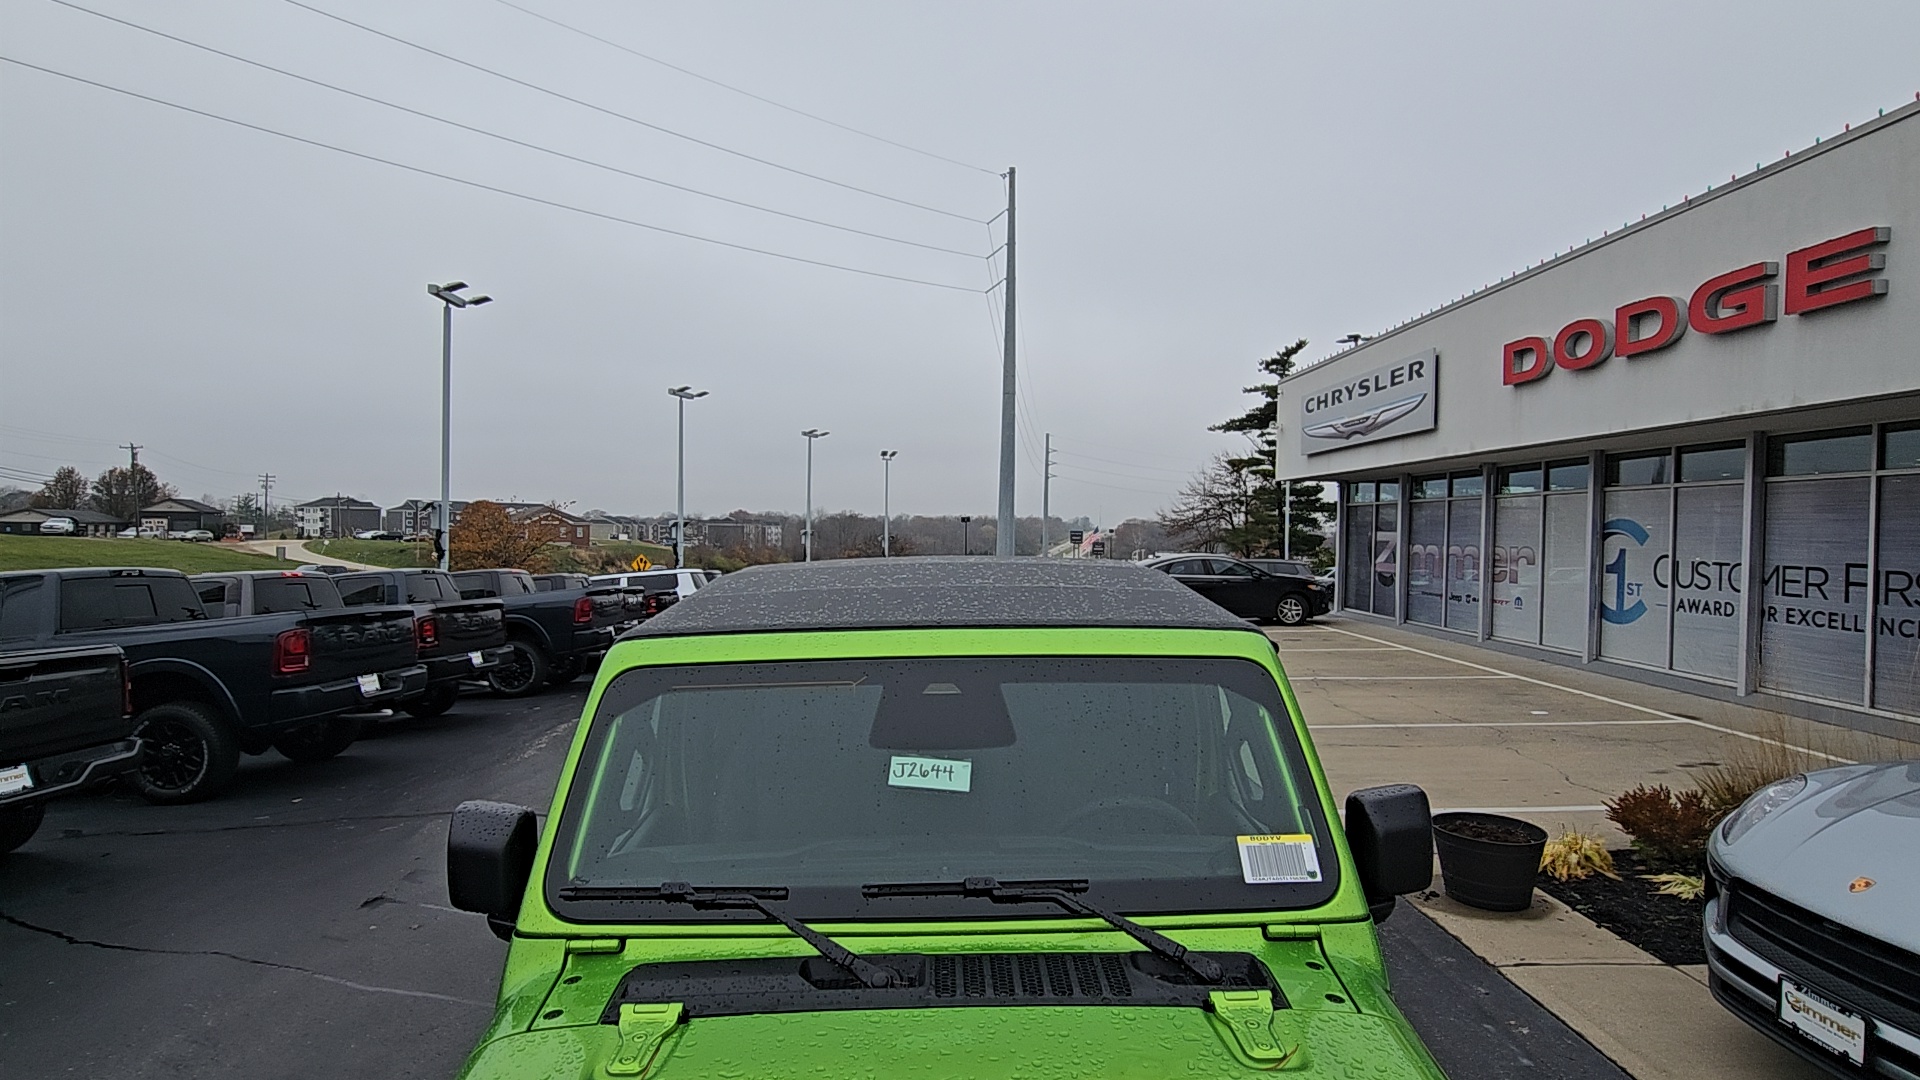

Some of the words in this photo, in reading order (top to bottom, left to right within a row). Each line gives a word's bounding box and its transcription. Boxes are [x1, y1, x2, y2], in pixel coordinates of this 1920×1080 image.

[1503, 226, 1892, 386] DODGE
[1305, 360, 1425, 413] CHRYSLER
[1375, 531, 1536, 584] Zmmer
[1676, 598, 1735, 617] AWARD
[1786, 608, 1920, 640] EXCELLNC
[893, 762, 954, 782] J2644
[1789, 993, 1862, 1042] Zimmer
[1800, 985, 1842, 1012] Zimmer
